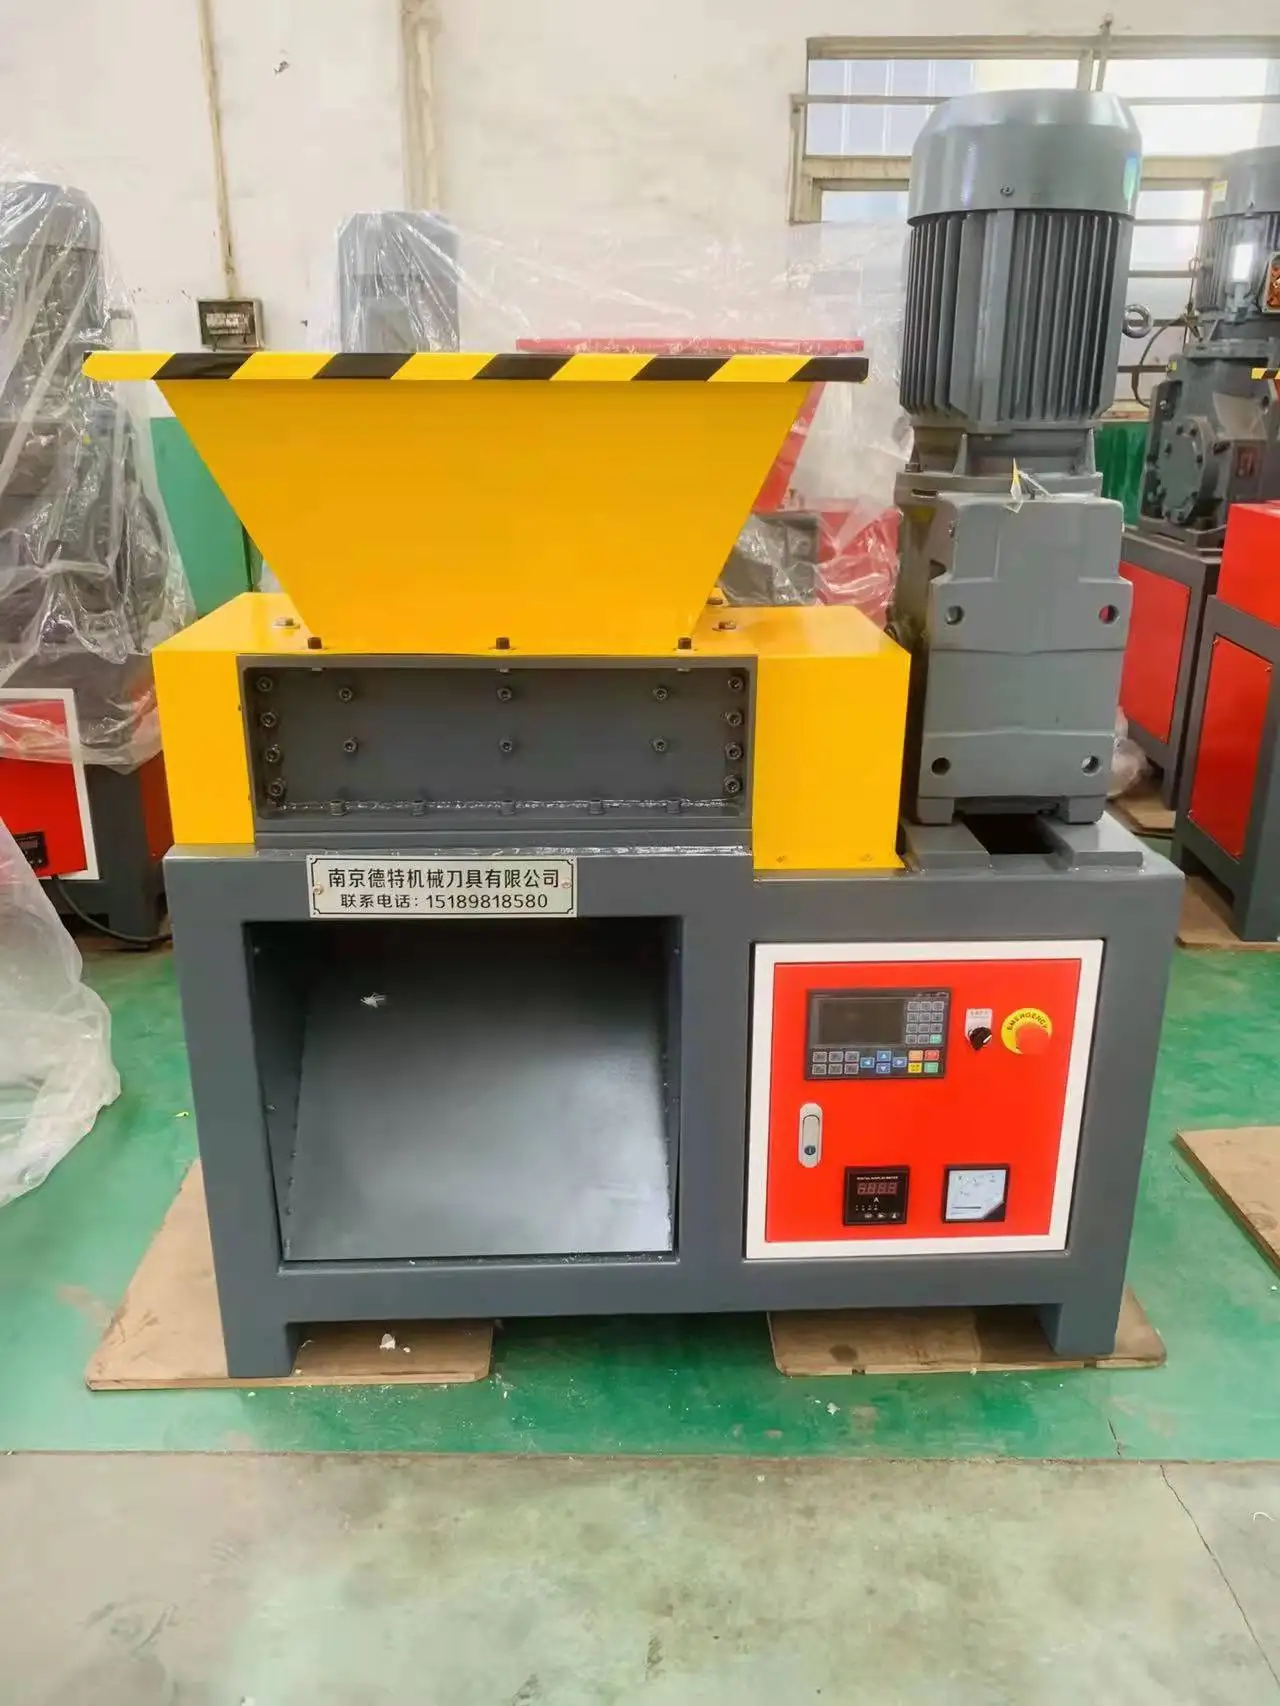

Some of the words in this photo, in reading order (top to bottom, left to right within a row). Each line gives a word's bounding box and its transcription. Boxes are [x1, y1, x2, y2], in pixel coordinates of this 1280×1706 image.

[328, 868, 559, 888] 南京德特机械刀具有限公司
